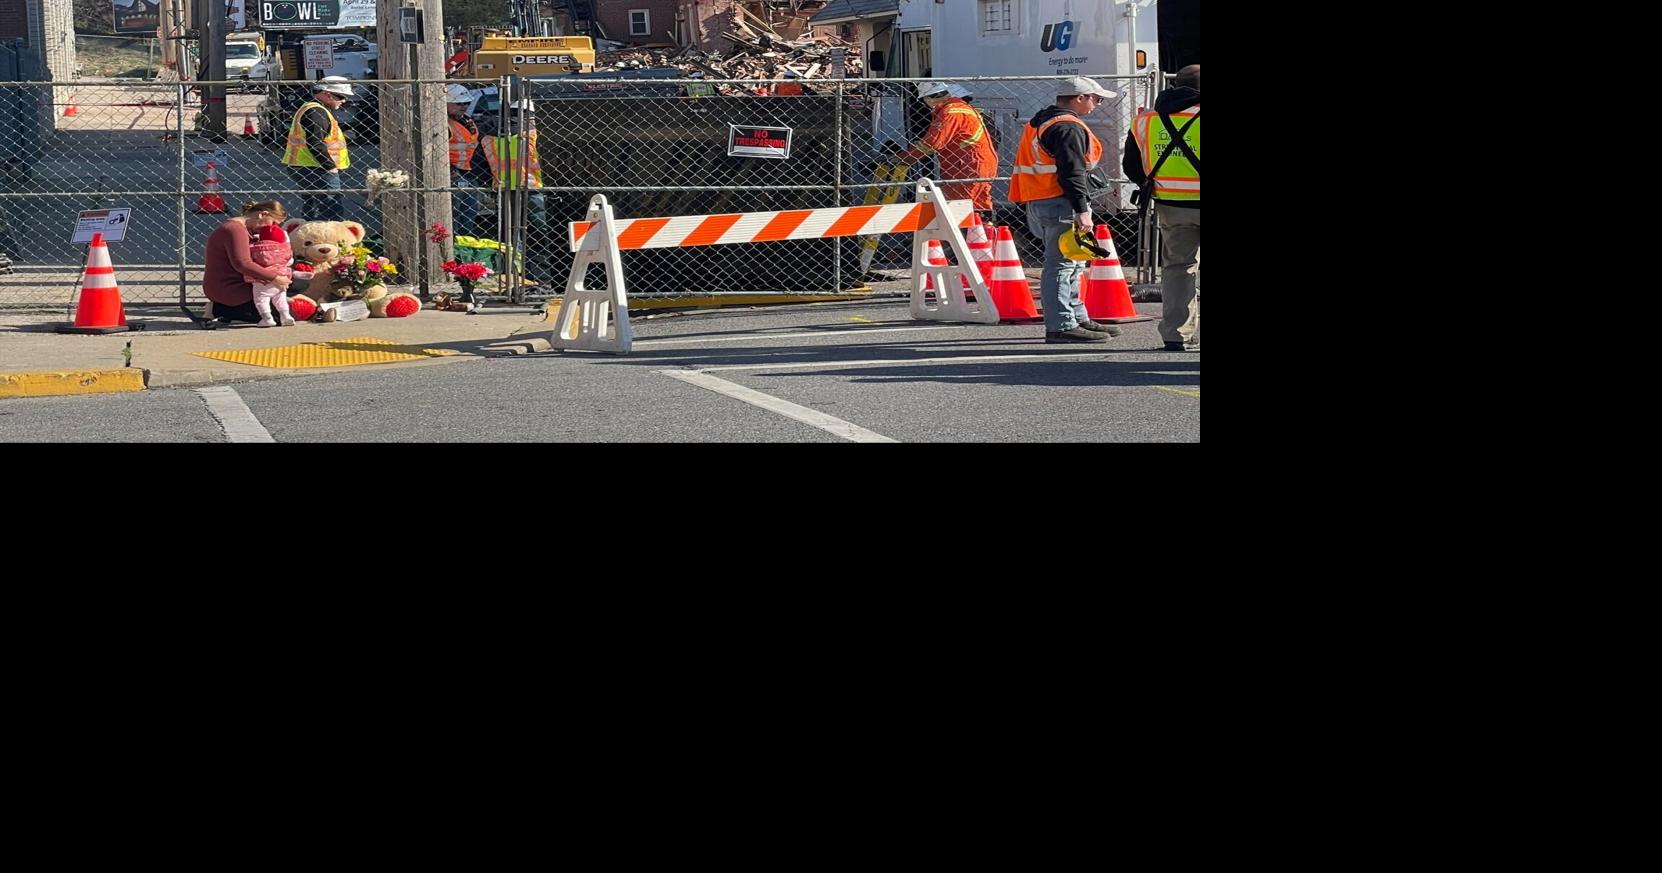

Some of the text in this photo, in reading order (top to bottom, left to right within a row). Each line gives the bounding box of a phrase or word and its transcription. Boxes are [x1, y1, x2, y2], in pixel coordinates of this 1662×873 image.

[263, 2, 320, 20] BOWL
[1040, 20, 1081, 52] UGI
[512, 55, 570, 64] DEERE
[1049, 57, 1063, 67] Energy
[753, 130, 768, 138] NO
[735, 137, 785, 147] TRESPASSING
